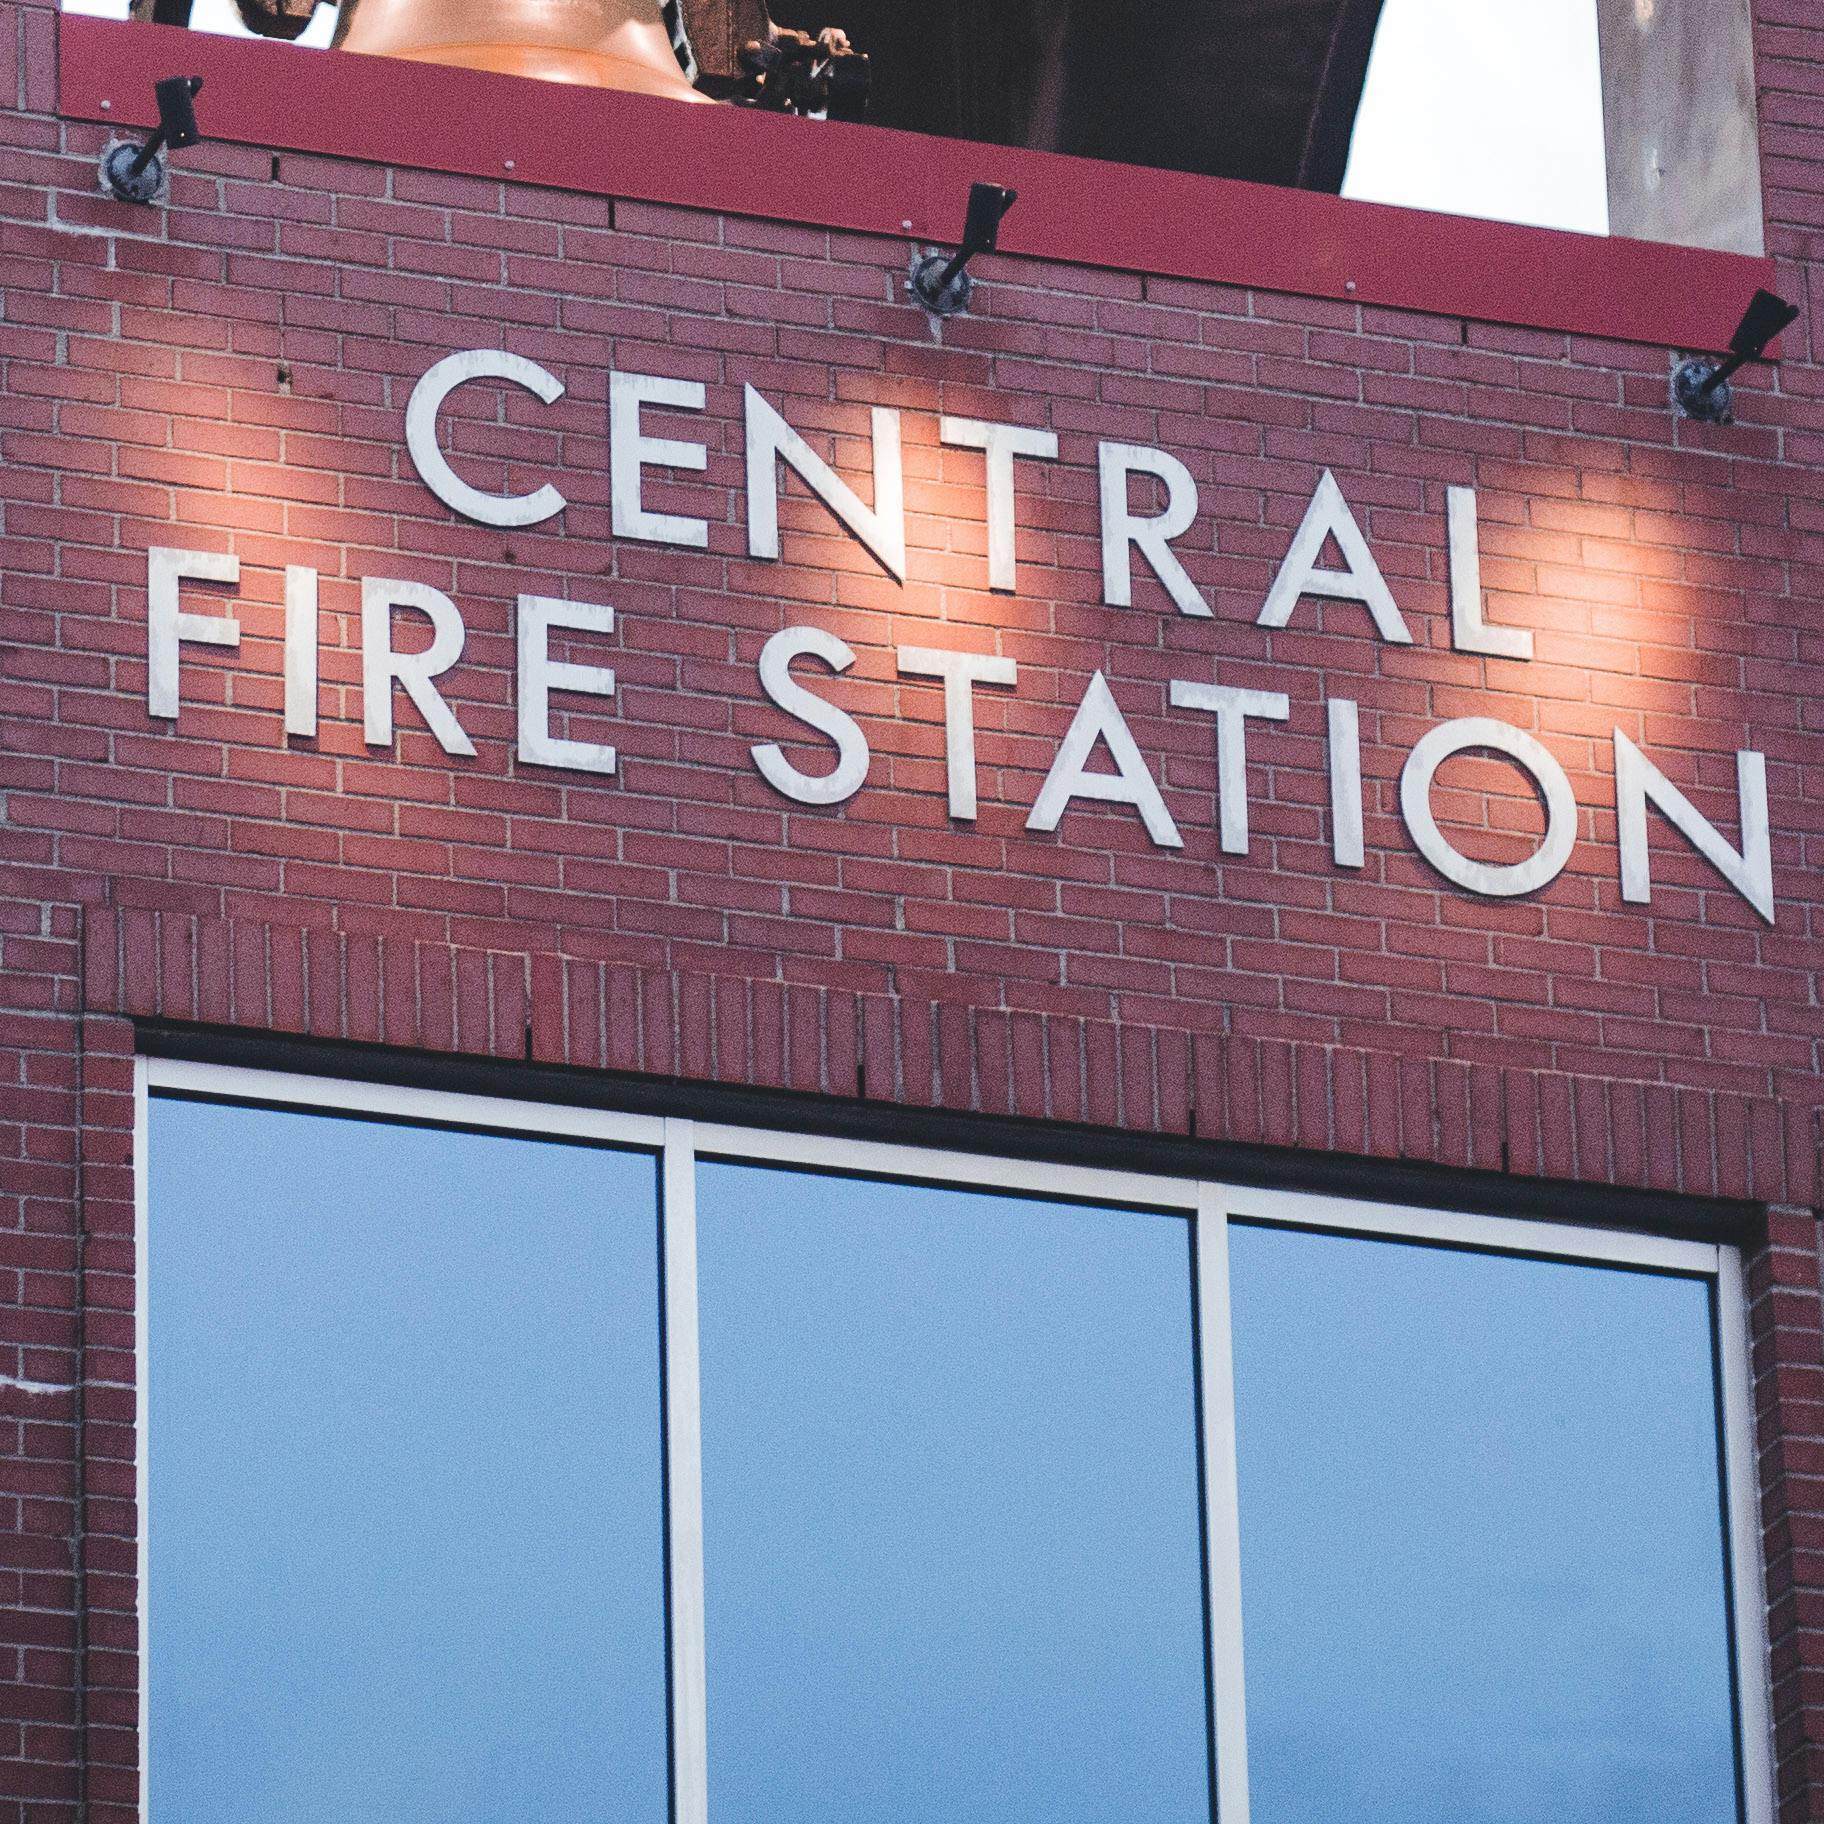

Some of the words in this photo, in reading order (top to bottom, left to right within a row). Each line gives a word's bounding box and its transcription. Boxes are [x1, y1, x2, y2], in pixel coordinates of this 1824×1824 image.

[406, 348, 1534, 660] CENTRAL
[147, 546, 617, 774] FIRE
[751, 625, 1776, 924] STATION
